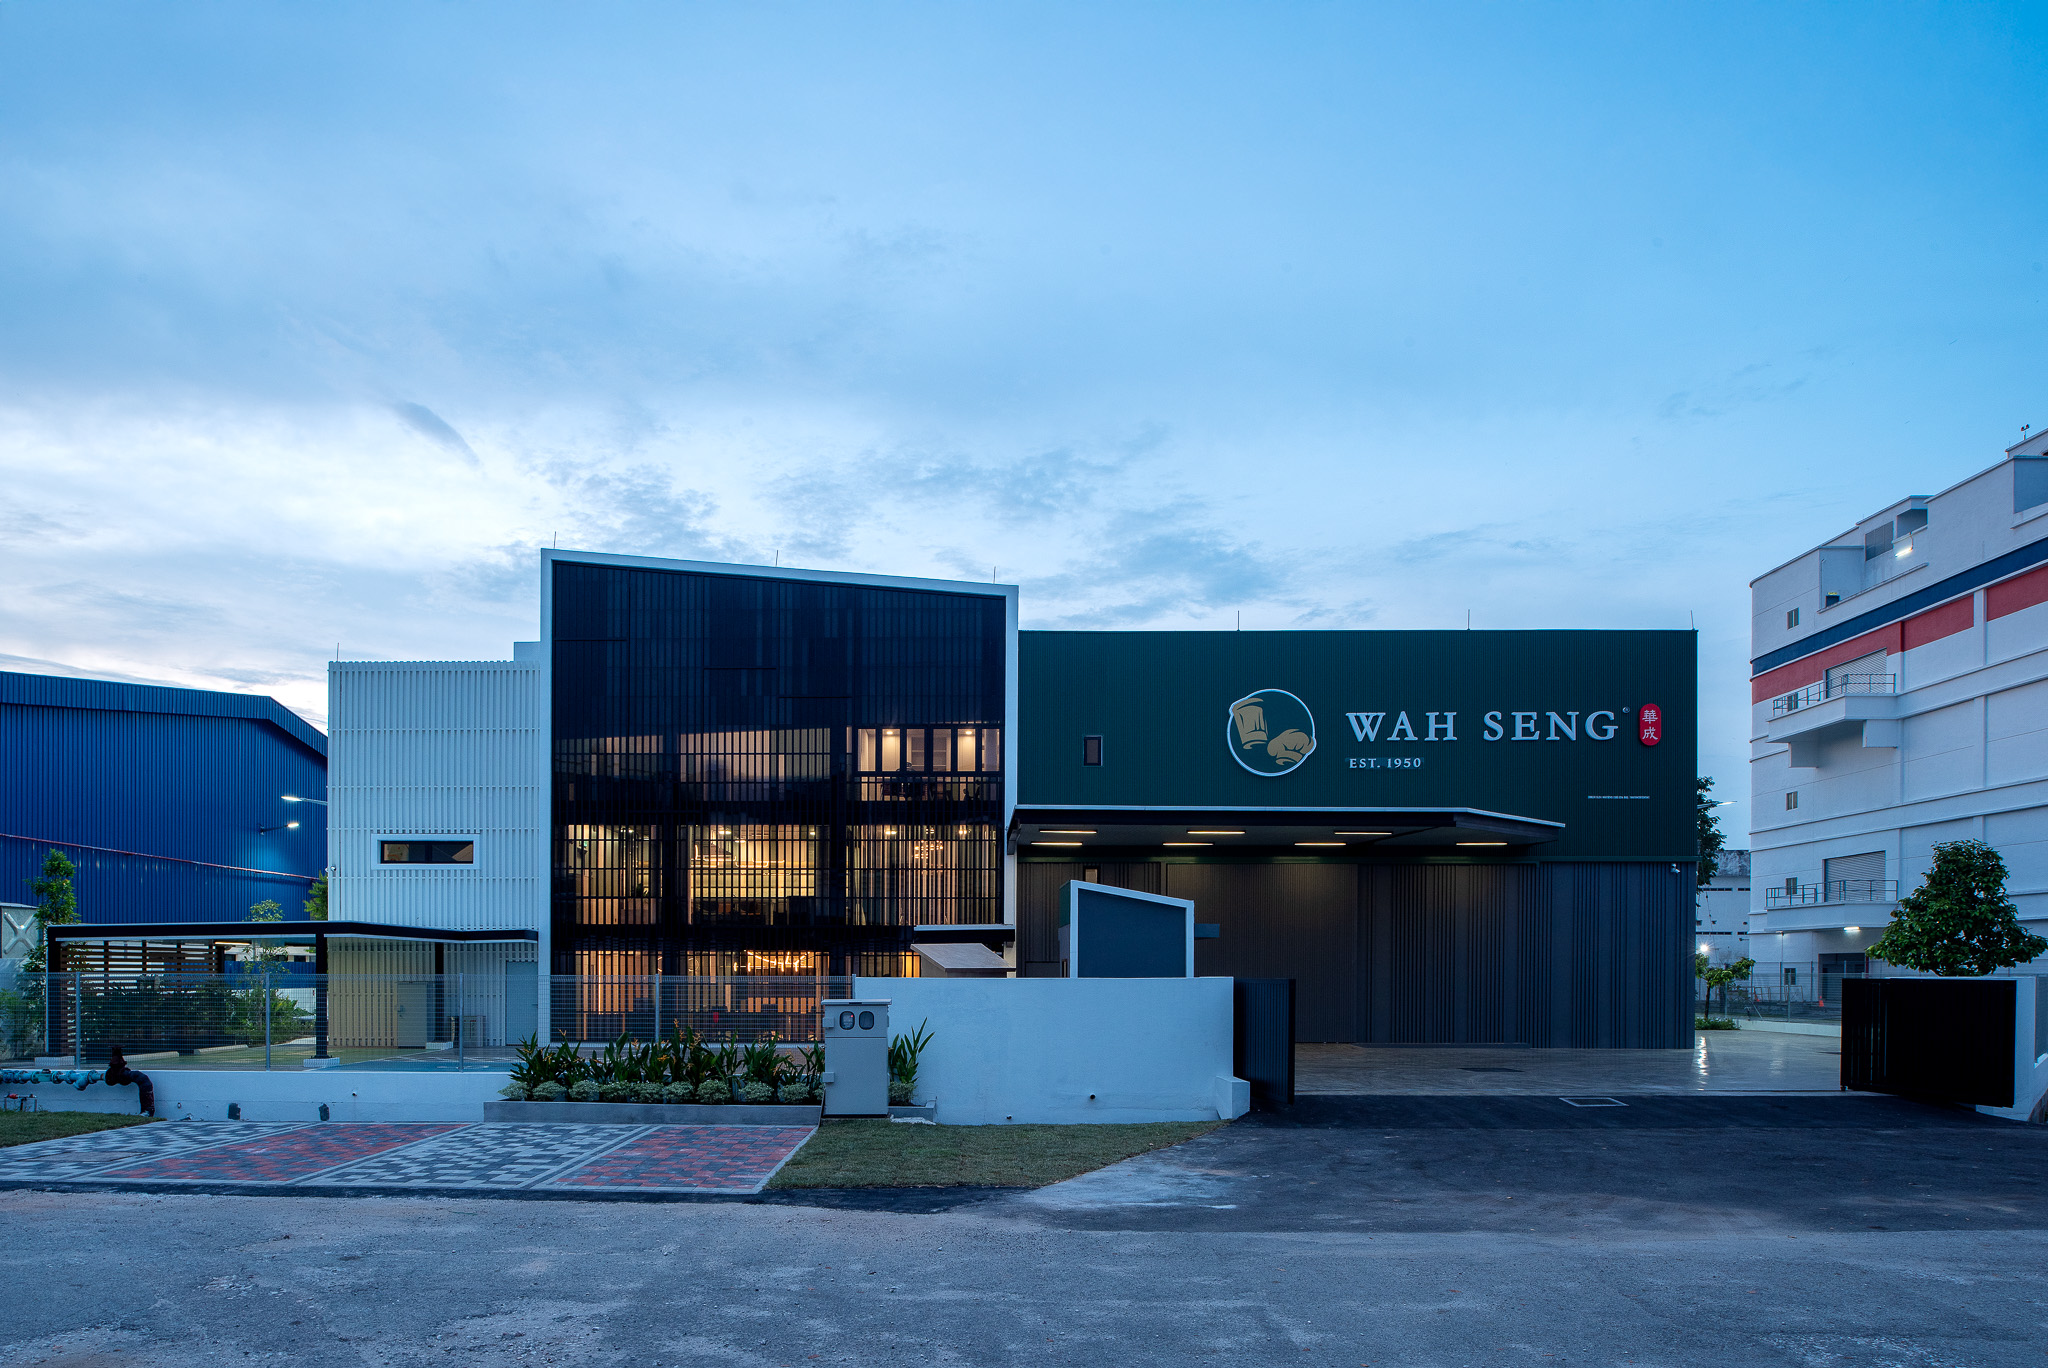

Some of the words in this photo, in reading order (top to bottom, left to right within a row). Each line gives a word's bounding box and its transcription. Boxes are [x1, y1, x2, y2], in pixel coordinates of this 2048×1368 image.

[1346, 711, 1457, 742] WAH
[1483, 711, 1618, 741] SENG
[1642, 709, 1658, 740] 華成
[1349, 758, 1381, 769] EST.
[1387, 758, 1422, 769] 1950
